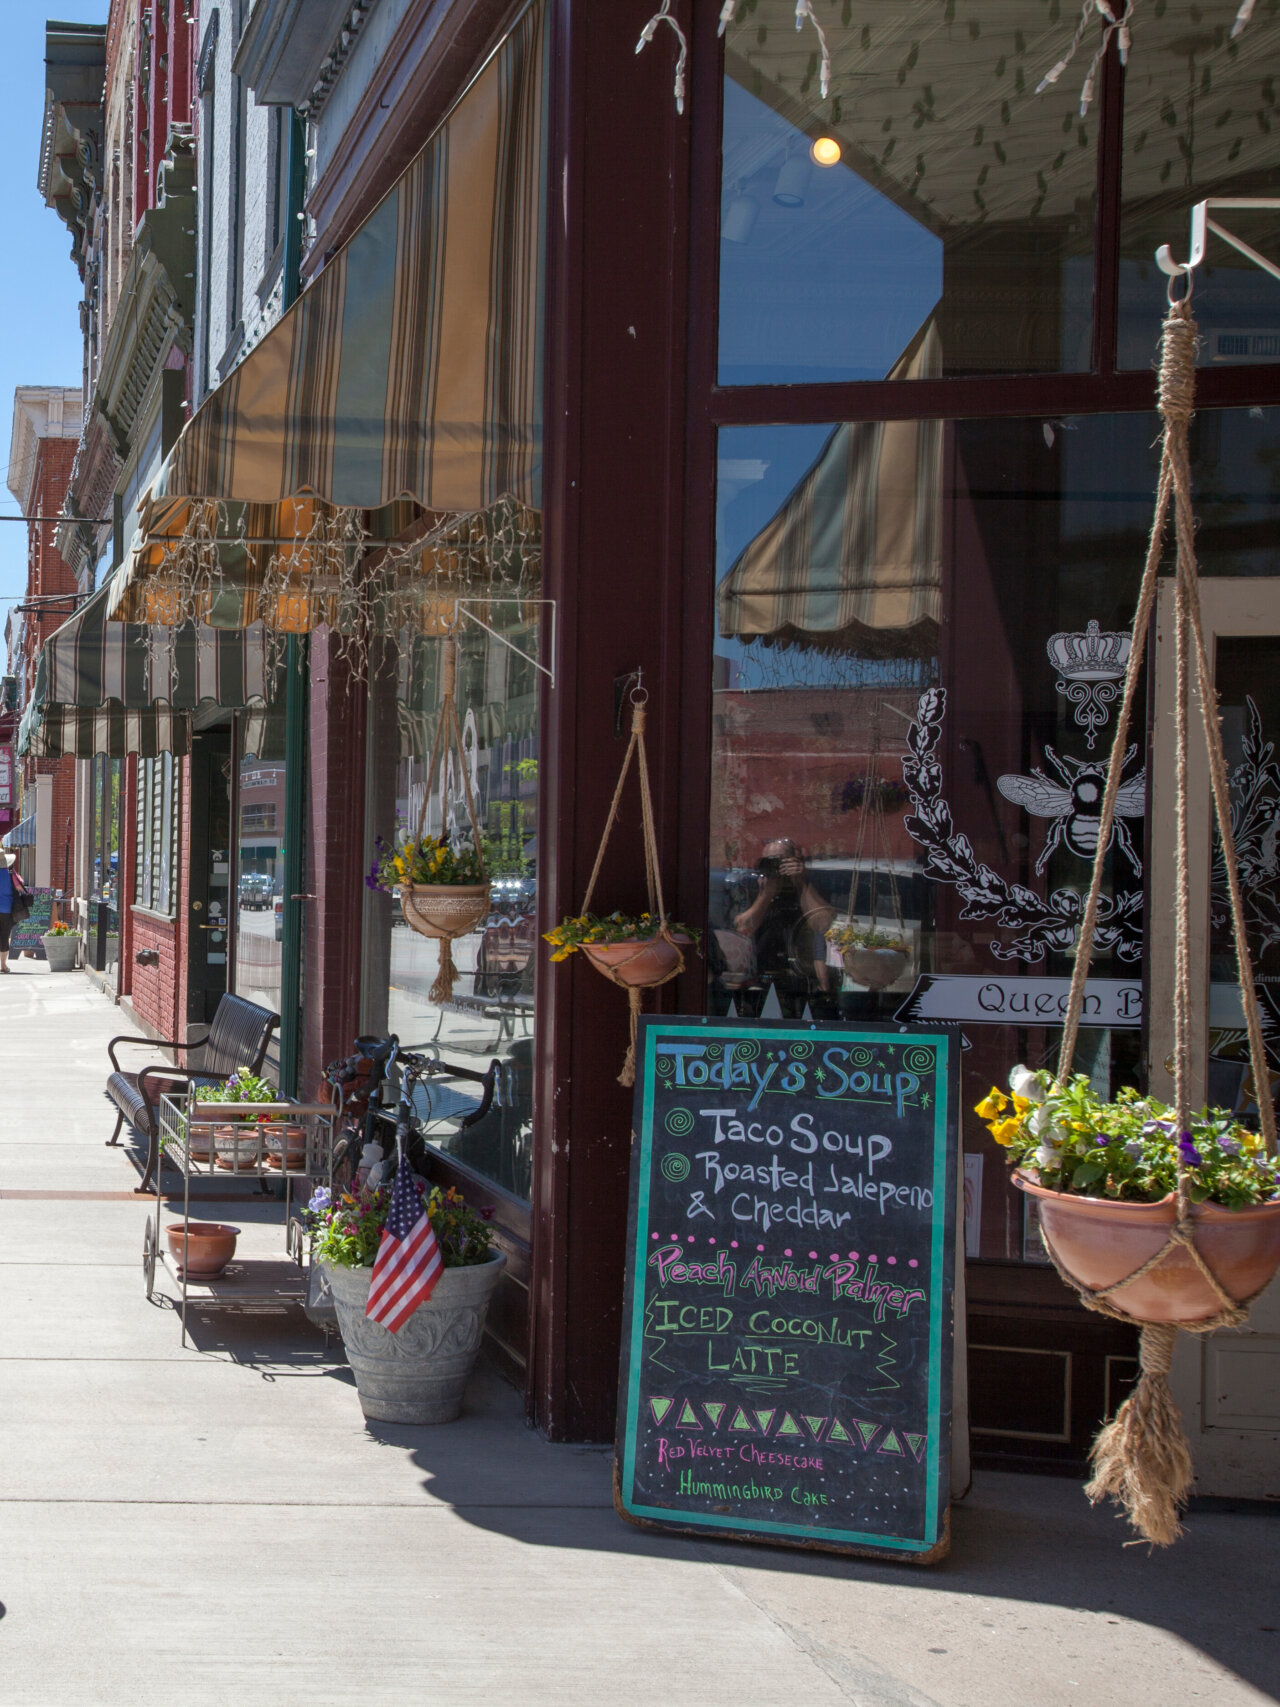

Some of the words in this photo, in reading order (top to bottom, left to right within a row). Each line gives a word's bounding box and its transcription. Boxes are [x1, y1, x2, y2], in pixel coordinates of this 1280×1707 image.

[655, 1043, 808, 1112] Today's
[817, 1047, 921, 1118] Soup
[699, 1109, 783, 1145] Taco
[790, 1113, 893, 1176] Soup
[686, 1191, 716, 1221] &
[730, 1193, 852, 1233] Cheddar
[695, 1151, 815, 1197] Roasted
[823, 1163, 934, 1216] Jalepeno
[648, 1244, 737, 1298] Peach
[823, 1260, 927, 1324] Palmer
[655, 1300, 733, 1331] ICED
[748, 1310, 872, 1350] COCONUT
[708, 1340, 799, 1376] LATTE
[655, 1438, 685, 1473] RED
